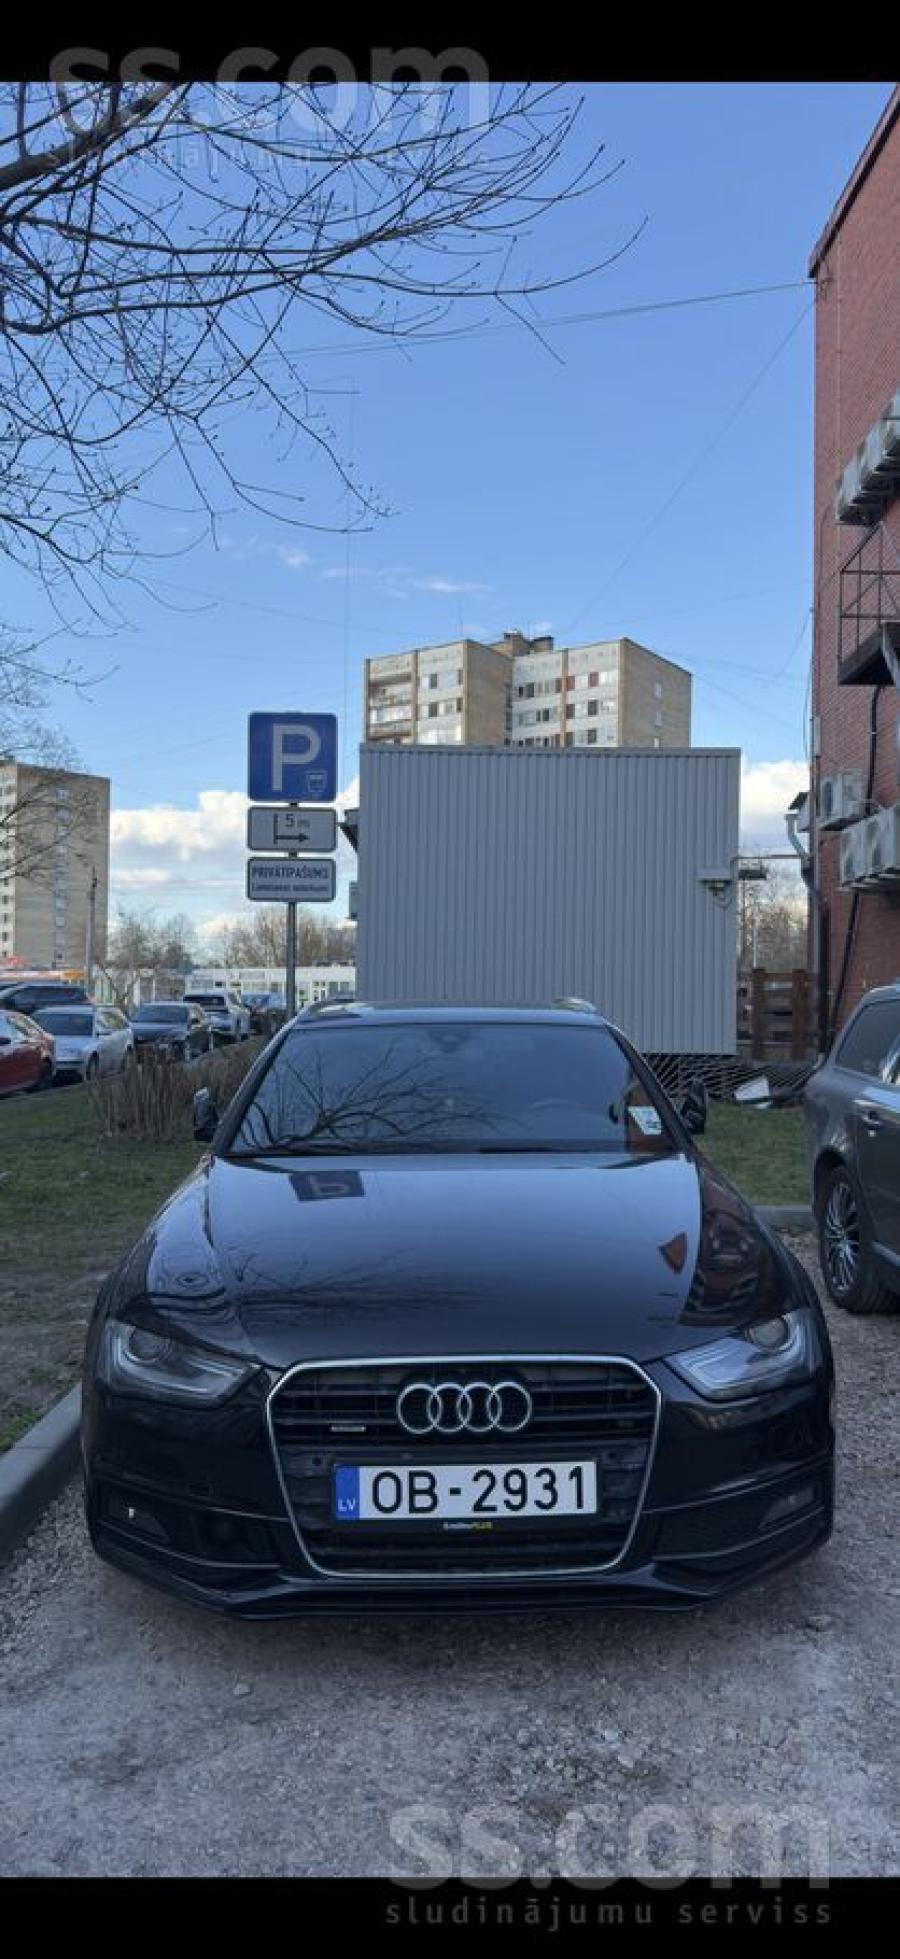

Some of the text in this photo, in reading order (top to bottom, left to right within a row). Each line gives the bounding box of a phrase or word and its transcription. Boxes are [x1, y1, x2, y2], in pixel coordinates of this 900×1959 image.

[271, 723, 321, 792] P
[285, 813, 296, 828] 5
[337, 1497, 356, 1512] LV
[372, 1465, 584, 1515] OB-2931
